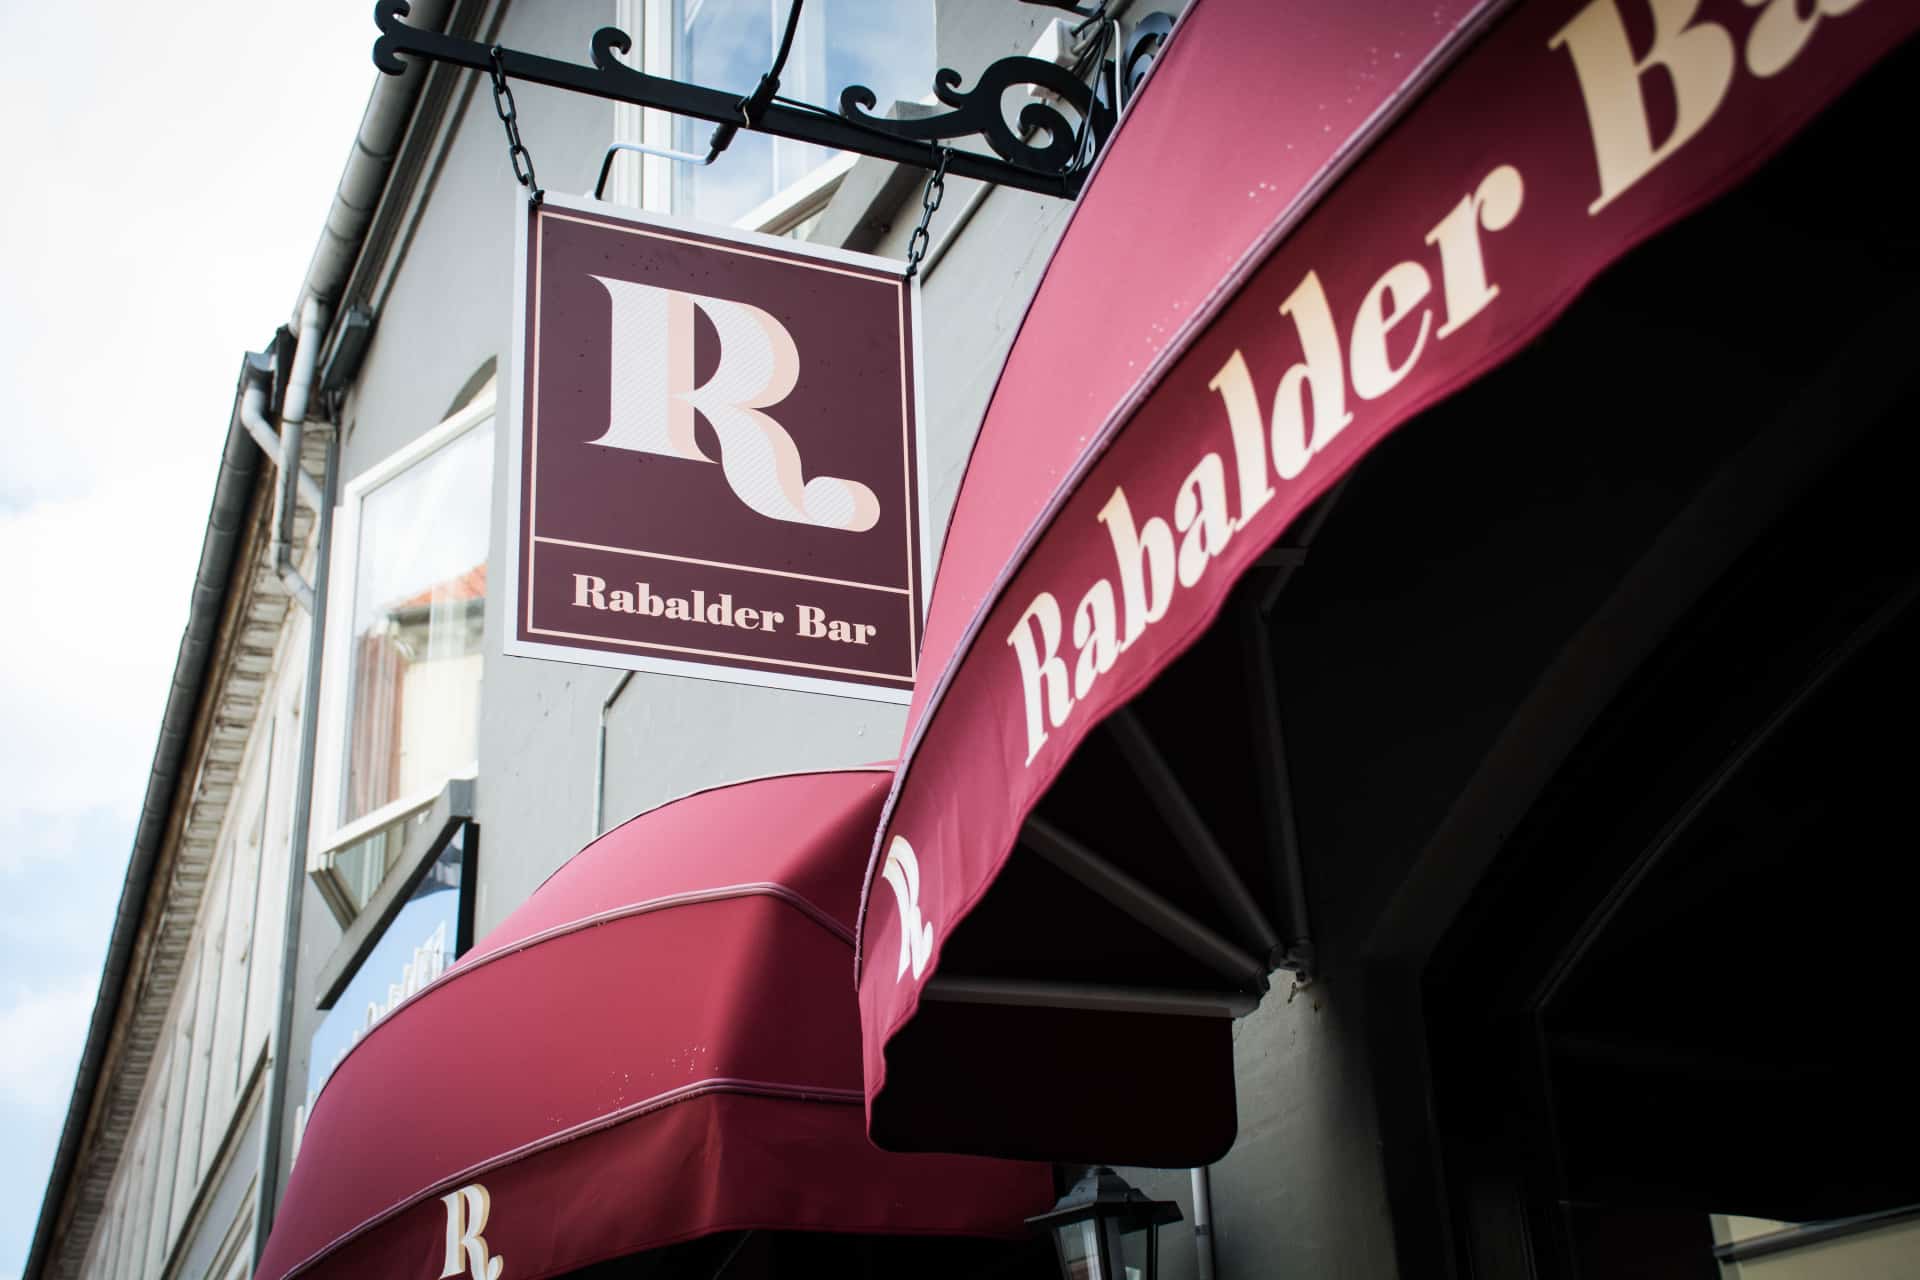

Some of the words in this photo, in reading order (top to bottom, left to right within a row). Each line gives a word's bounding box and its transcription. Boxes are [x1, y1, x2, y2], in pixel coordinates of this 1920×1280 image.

[584, 274, 880, 532] R
[1007, 165, 1525, 767] Rabalder
[572, 573, 784, 632] Rabalder
[796, 604, 877, 646] Bar
[882, 835, 933, 984] R
[439, 1183, 504, 1280] R
